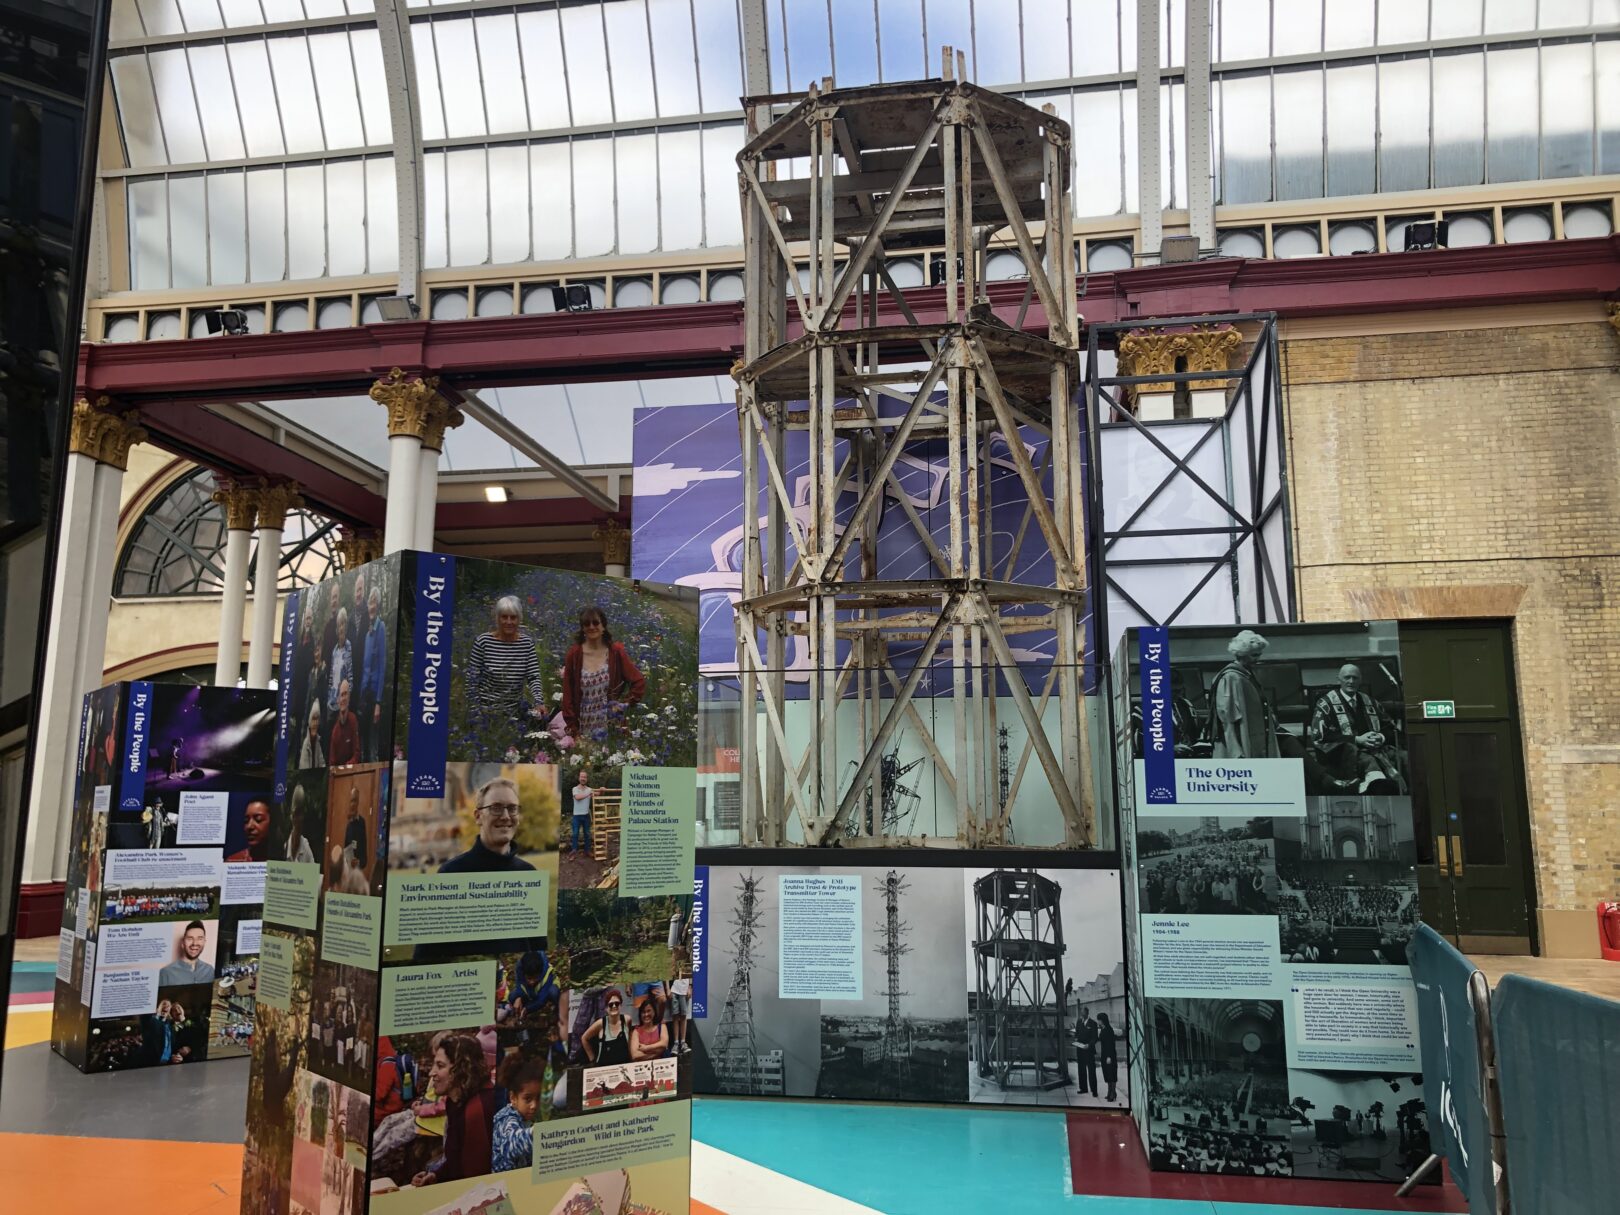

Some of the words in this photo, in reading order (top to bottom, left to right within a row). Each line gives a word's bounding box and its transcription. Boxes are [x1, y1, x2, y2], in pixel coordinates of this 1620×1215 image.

[422, 576, 446, 604] By
[426, 610, 444, 646] the
[1145, 643, 1162, 663] By
[419, 652, 442, 725] People
[1150, 668, 1164, 694] the
[133, 694, 147, 709] By
[134, 712, 145, 731] the
[1149, 699, 1166, 751] People
[129, 734, 143, 773] People
[1186, 767, 1212, 778] The
[1216, 767, 1252, 780] Open
[1186, 781, 1258, 794] University
[400, 892, 467, 902] Environmental
[469, 890, 528, 900] Sustainability
[401, 883, 425, 892] Mark
[428, 882, 458, 891] Evison
[469, 881, 490, 890] Head
[503, 880, 522, 888] Park
[525, 880, 541, 888] and
[694, 879, 703, 896] By
[693, 901, 703, 923] the
[692, 927, 702, 972] People
[396, 973, 424, 982] Laura
[426, 972, 442, 980] Fox
[452, 968, 478, 978] Artist
[540, 1128, 575, 1140] Kathryn
[605, 1121, 620, 1130] and
[622, 1115, 659, 1126] Katherine
[541, 1137, 586, 1150] Mengardon
[594, 1131, 612, 1141] Wild
[623, 1128, 636, 1136] the
[637, 1125, 654, 1134] Park
